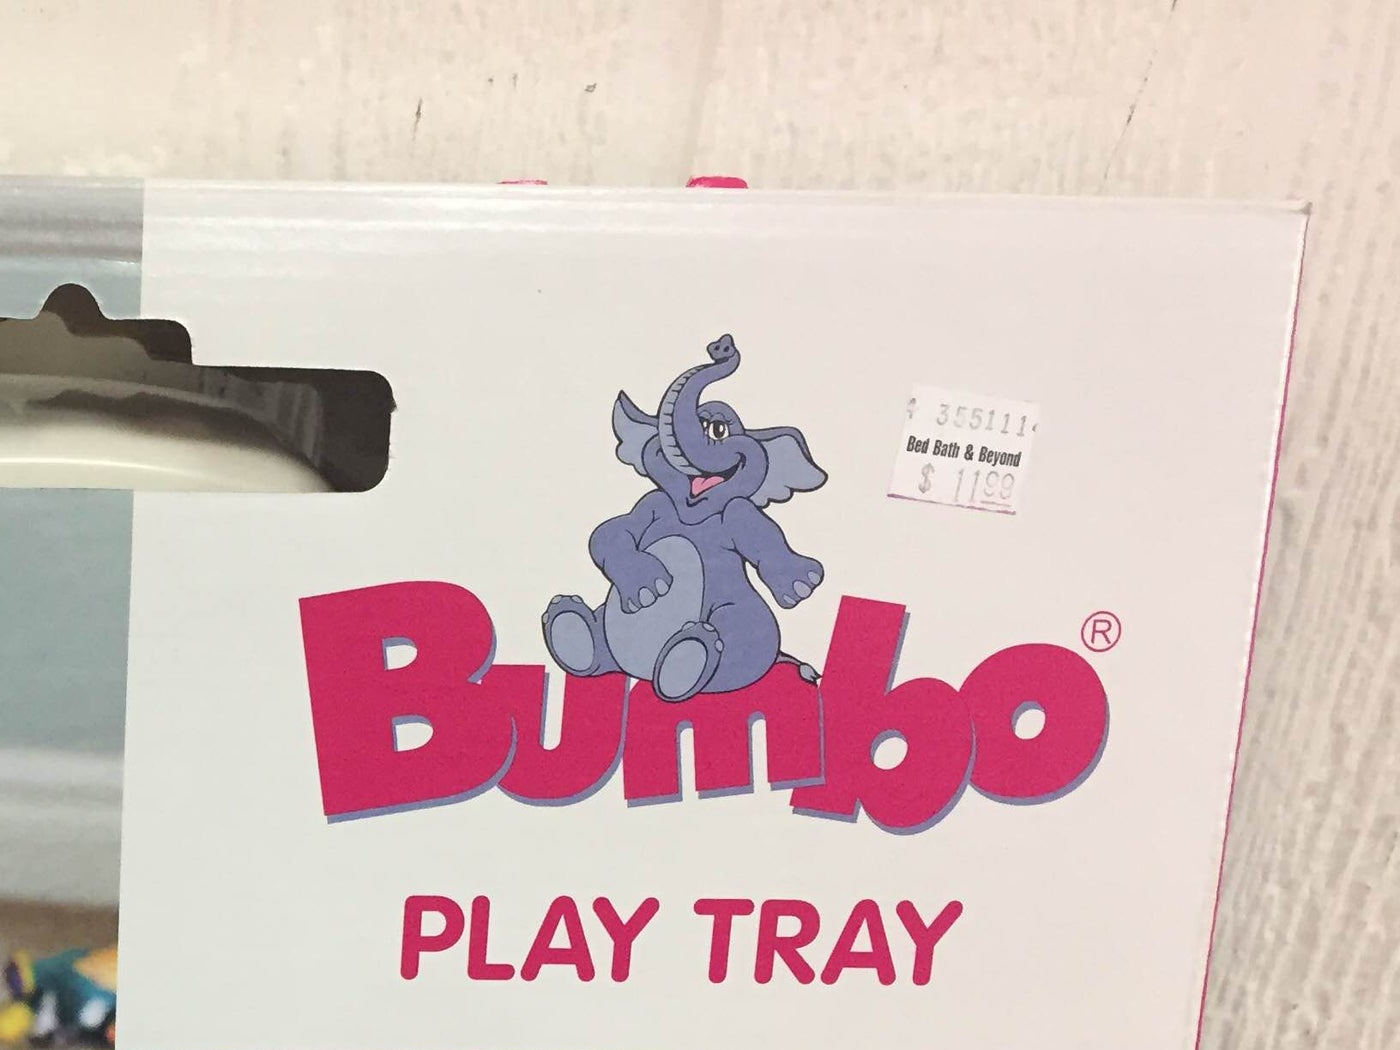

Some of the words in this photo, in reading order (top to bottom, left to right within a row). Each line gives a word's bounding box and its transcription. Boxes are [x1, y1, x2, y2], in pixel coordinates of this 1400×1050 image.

[907, 436, 929, 454] Bed
[933, 440, 960, 458] Bath
[964, 444, 973, 460] &
[978, 446, 1021, 467] Beyond
[298, 580, 1111, 836] Bumbo
[400, 895, 660, 982] PLAY
[694, 899, 963, 986] TRAY
